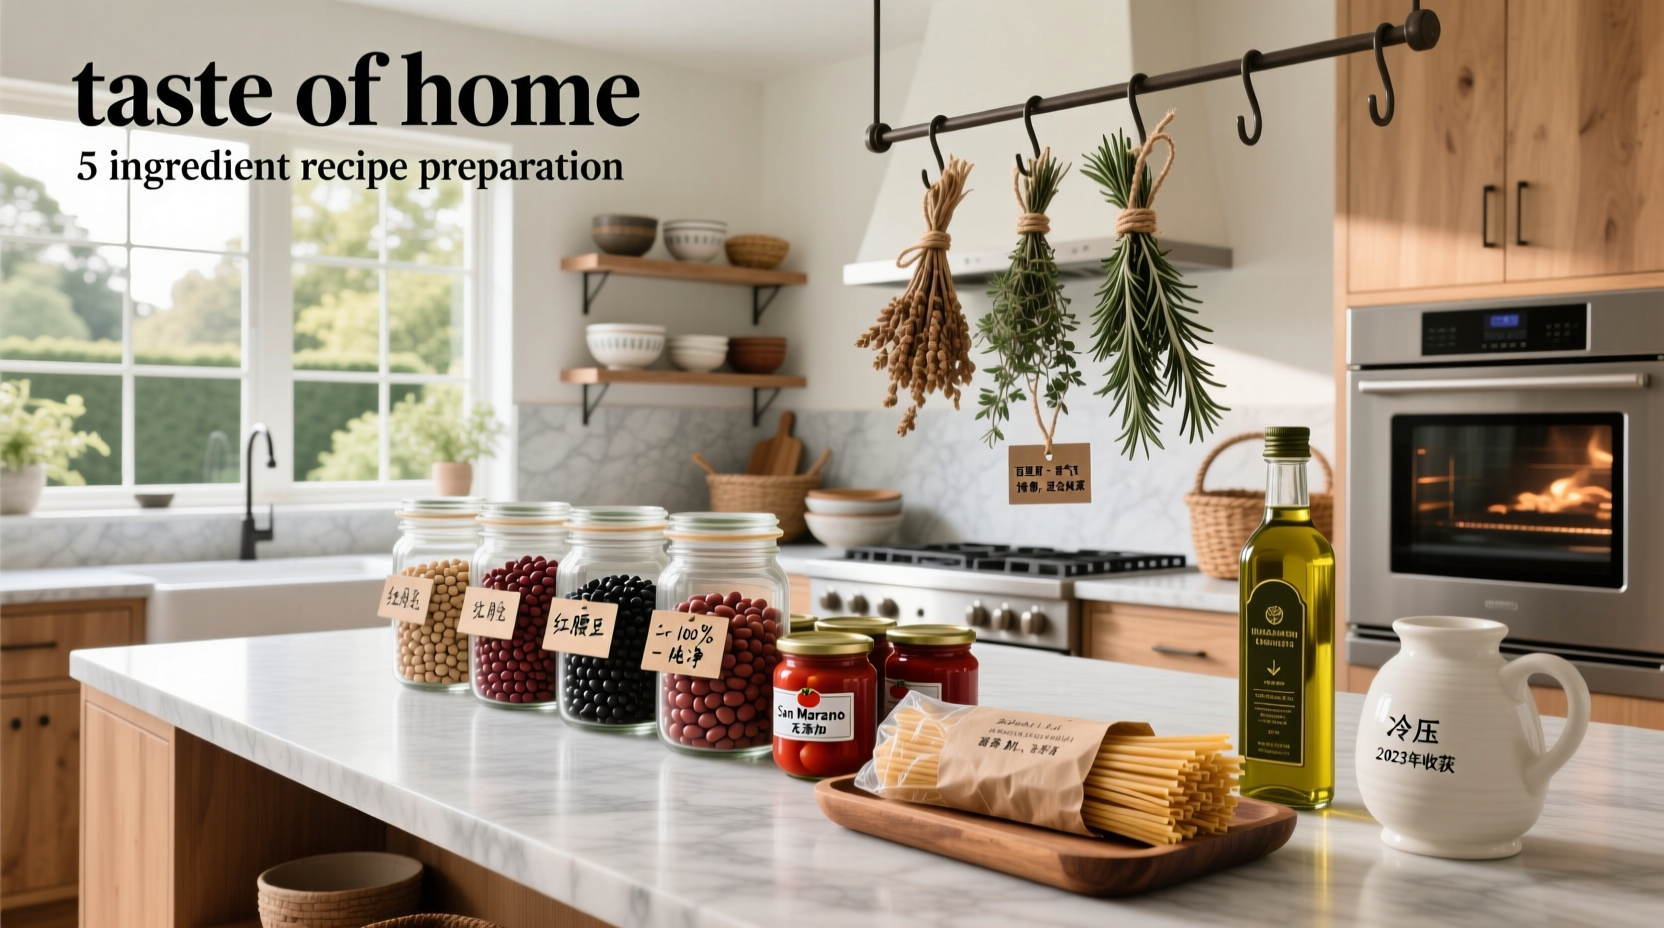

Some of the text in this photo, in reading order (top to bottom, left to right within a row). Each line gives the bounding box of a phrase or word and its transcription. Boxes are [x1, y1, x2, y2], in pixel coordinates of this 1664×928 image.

[677, 624, 714, 647] 100%
[777, 705, 794, 719] San
[1386, 714, 1440, 745] 冷压
[1375, 747, 1456, 774] 2023年收获
